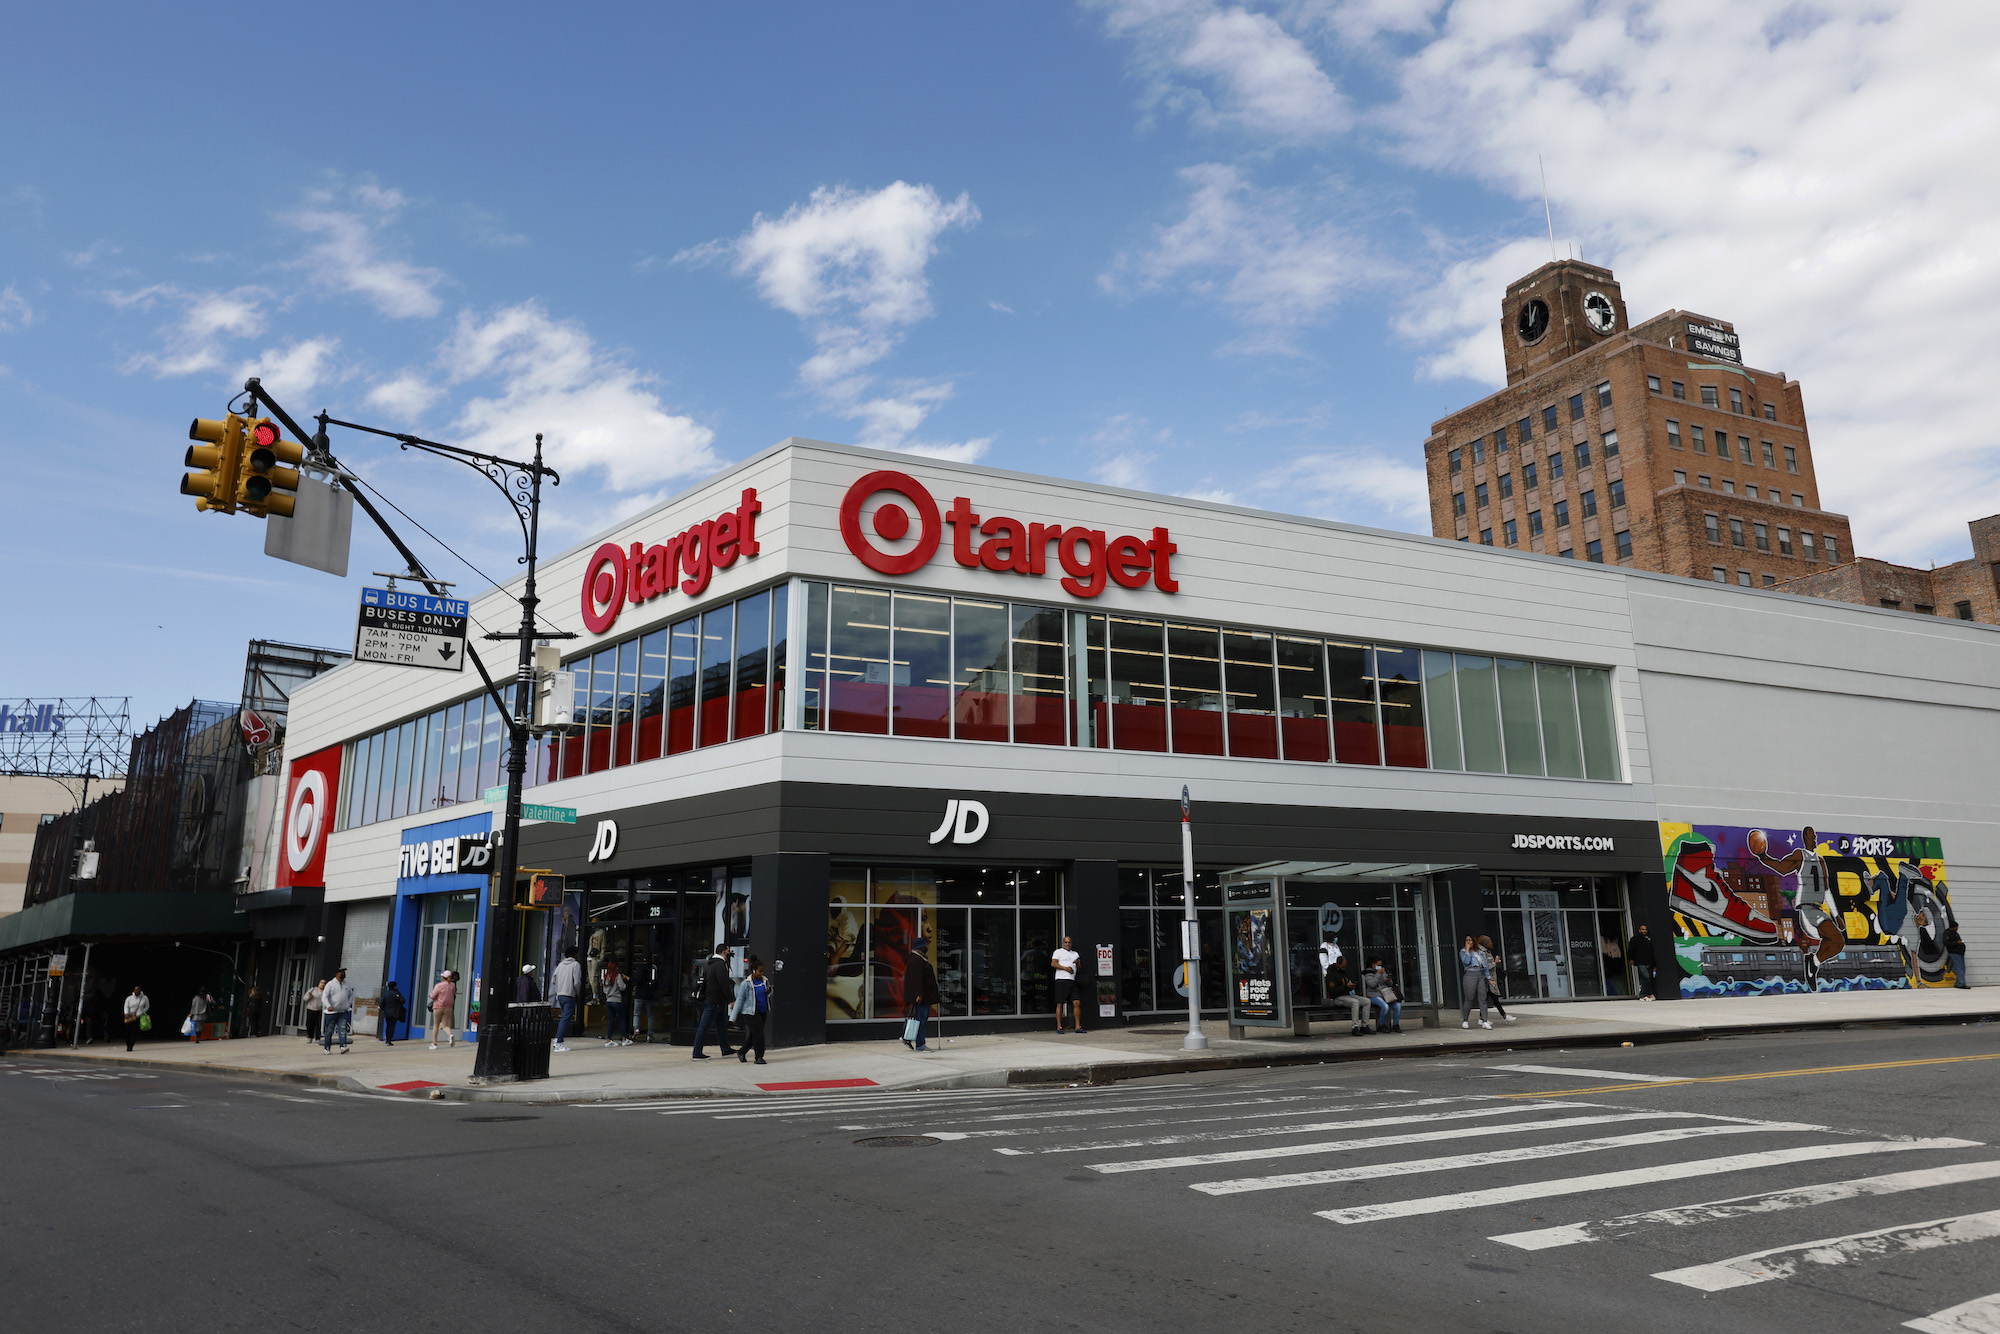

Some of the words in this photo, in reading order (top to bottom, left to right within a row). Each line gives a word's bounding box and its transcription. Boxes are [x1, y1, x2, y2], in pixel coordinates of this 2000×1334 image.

[1688, 324, 1738, 344] EMIGNT
[1695, 340, 1737, 358] SAVINGS
[626, 487, 763, 597] target
[945, 496, 1180, 599] target
[386, 593, 418, 608] BUS
[424, 598, 467, 615] LANE
[366, 607, 417, 623] BUSES
[423, 614, 462, 628] ONLY
[366, 628, 388, 638] 7AM
[399, 632, 428, 643] NOON
[392, 622, 415, 632] RIGHT
[418, 626, 444, 635] TURNS
[365, 639, 388, 649] 2PM
[399, 642, 421, 652] 7PM
[363, 650, 387, 660] MON
[397, 654, 414, 663] FRI
[523, 805, 566, 822] Valentine
[929, 799, 990, 845] JD
[588, 819, 618, 863] JD
[1511, 834, 1615, 851] JDSPORTS.COM
[1840, 839, 1850, 850] JD
[1852, 836, 1895, 856] SPORTS
[461, 846, 491, 867] JD
[1810, 865, 1820, 892] 1
[650, 906, 661, 917] 215
[1322, 909, 1340, 926] JD
[1570, 940, 1593, 949] BRONX
[1098, 950, 1112, 959] FDC
